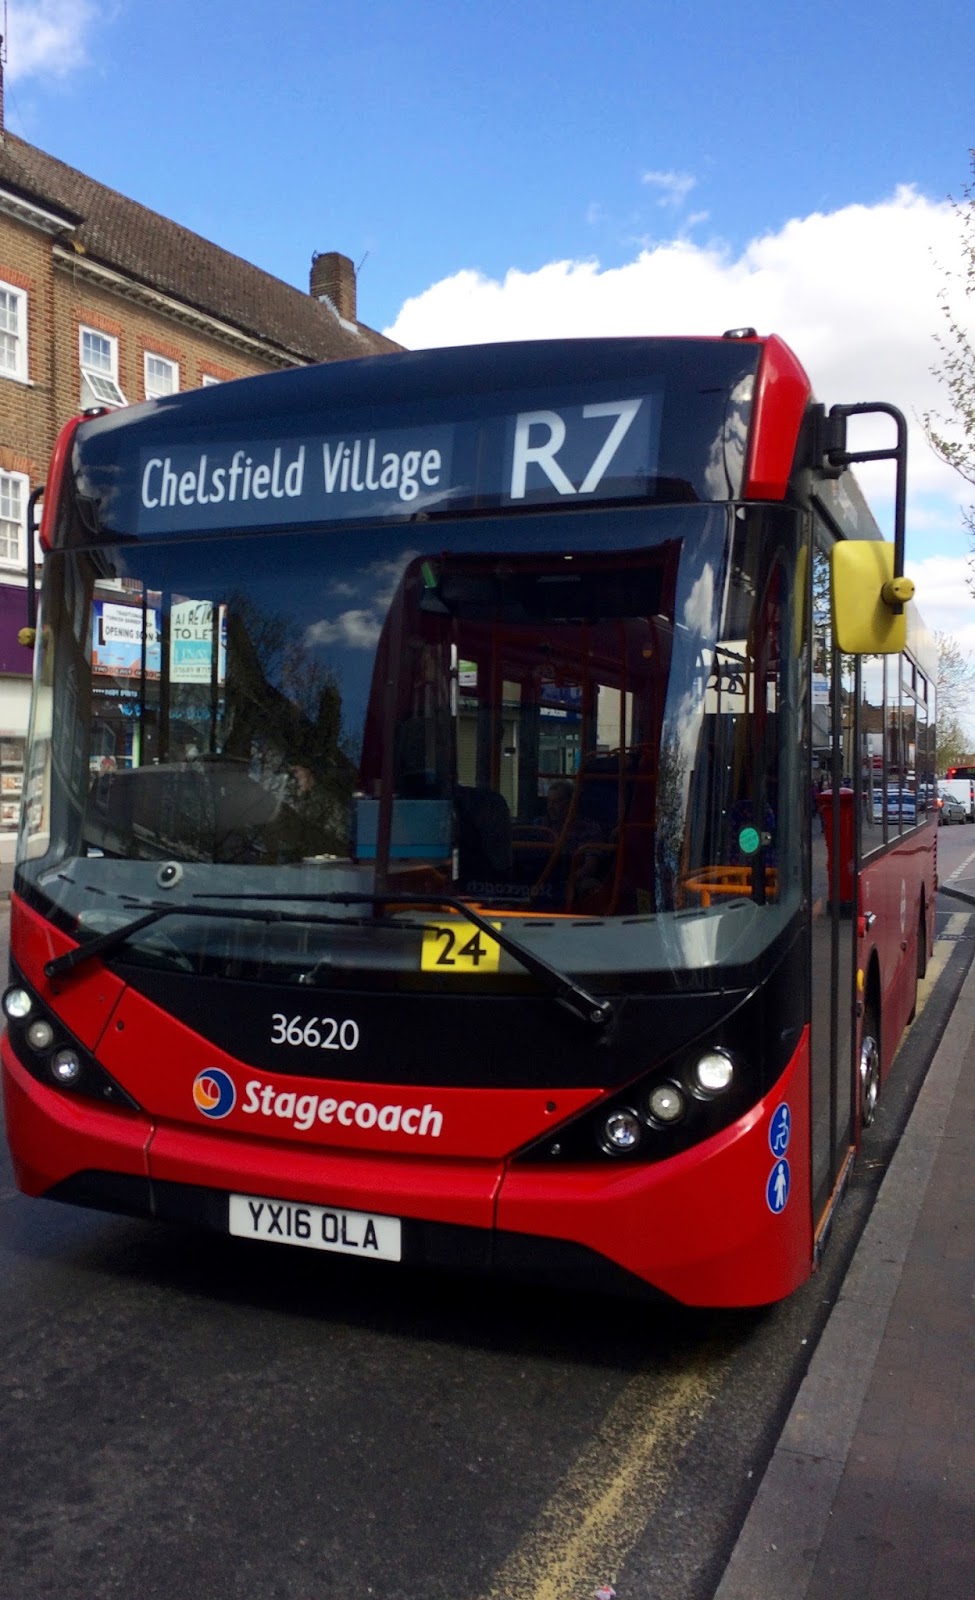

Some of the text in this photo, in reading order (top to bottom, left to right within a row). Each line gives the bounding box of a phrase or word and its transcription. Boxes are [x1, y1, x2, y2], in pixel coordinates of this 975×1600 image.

[510, 399, 643, 500] R7
[142, 439, 442, 509] Chelsfield Village
[105, 626, 134, 639] OPENING
[174, 628, 192, 639] TO
[436, 928, 487, 966] 24
[271, 1013, 359, 1050] 36620
[242, 1080, 444, 1137] Stagecoach
[248, 1202, 379, 1251] YX16 OLA
